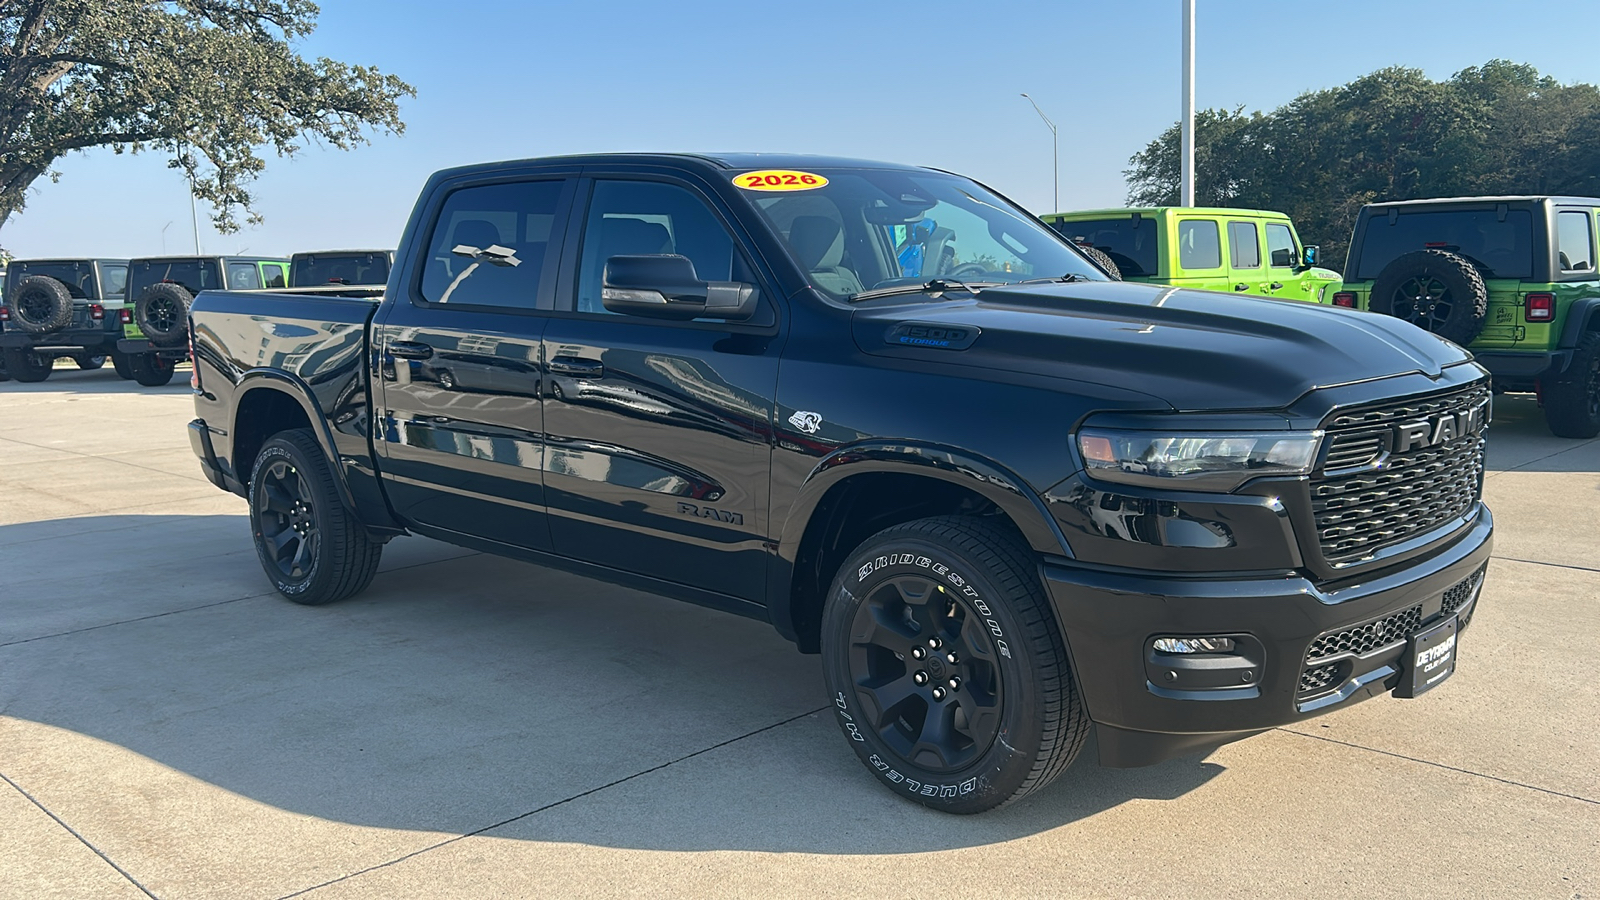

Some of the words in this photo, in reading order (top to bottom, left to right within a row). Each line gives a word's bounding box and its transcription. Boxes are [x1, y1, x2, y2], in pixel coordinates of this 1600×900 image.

[746, 174, 818, 188] 2026
[895, 325, 969, 340] 1500
[1398, 406, 1480, 452] RAM
[677, 501, 744, 526] RAM
[858, 553, 1012, 659] BRIDGESTONE
[869, 753, 977, 798] DUELER
